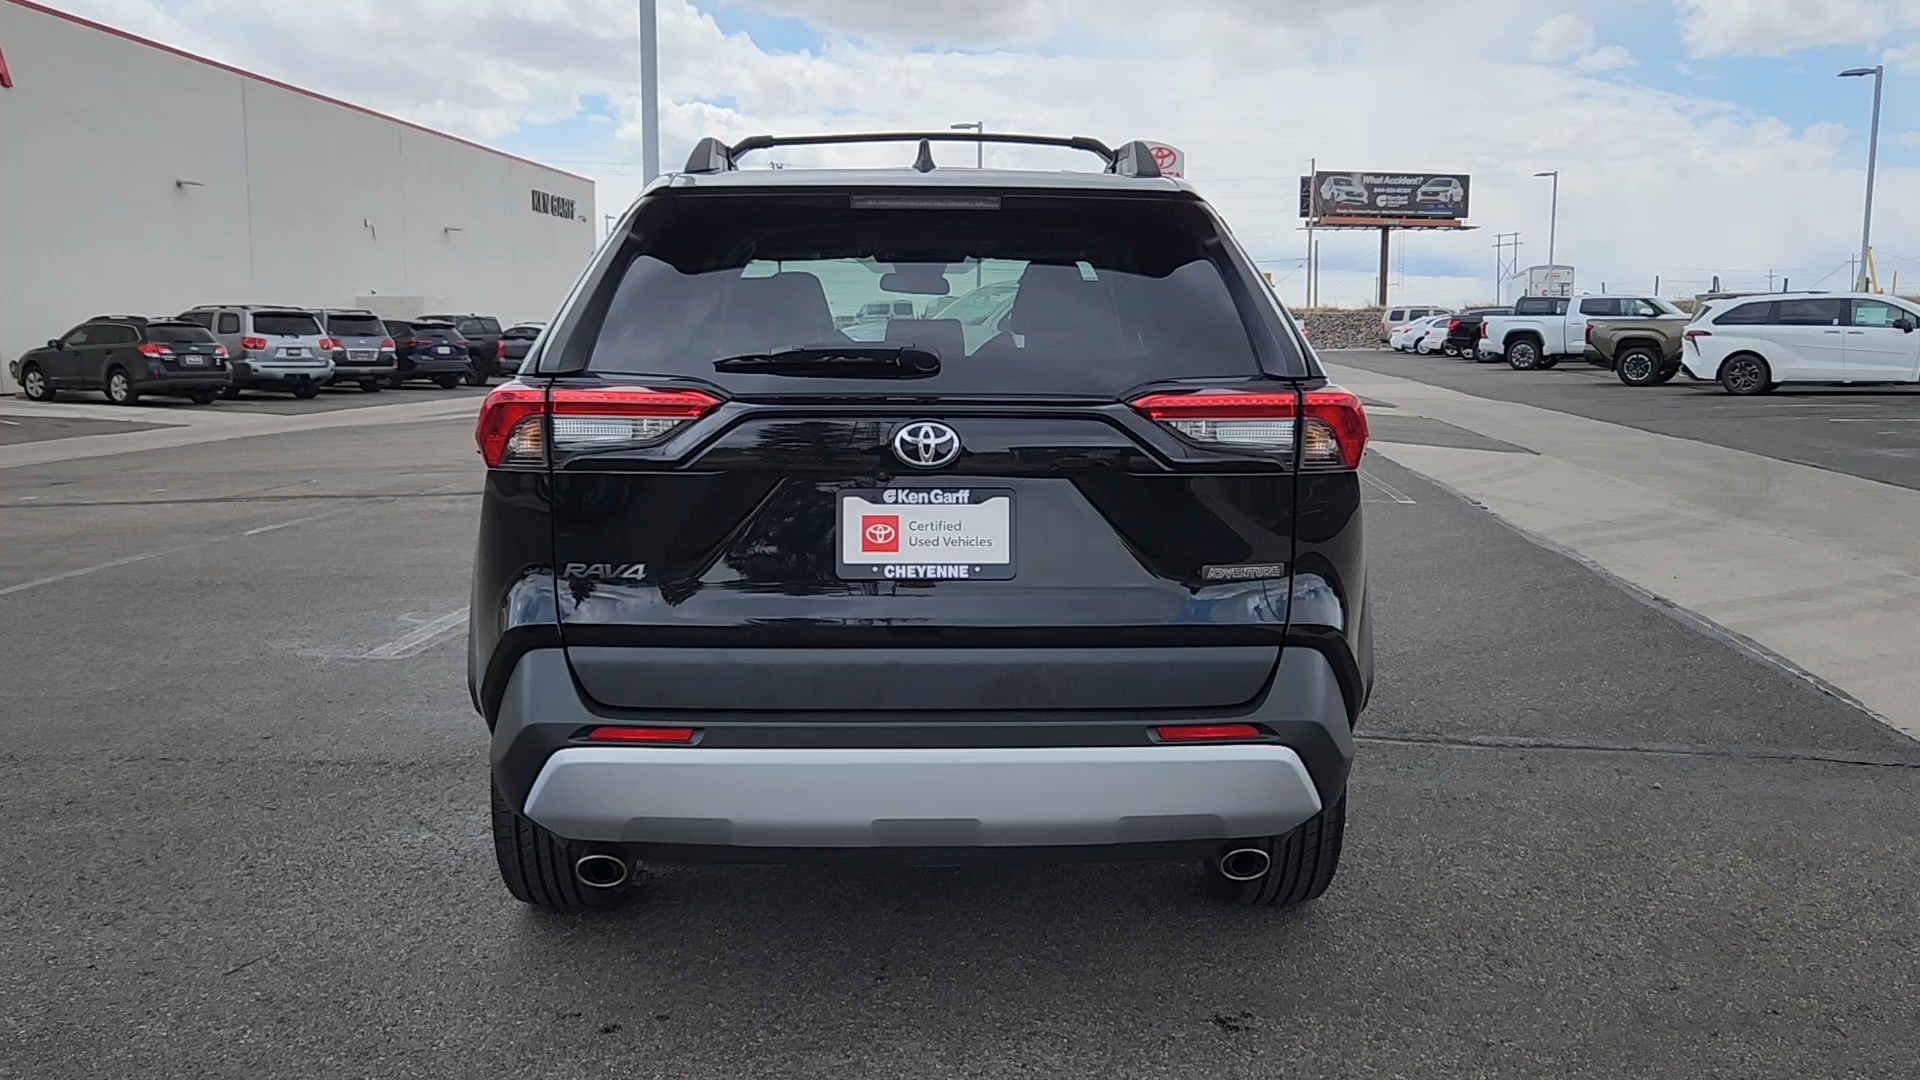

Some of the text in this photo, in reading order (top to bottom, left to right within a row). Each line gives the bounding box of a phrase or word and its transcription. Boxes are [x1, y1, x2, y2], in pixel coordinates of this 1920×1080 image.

[1363, 175, 1424, 187] What Accident?
[531, 189, 550, 214] KEN
[898, 489, 970, 504] Ken Garff
[908, 520, 962, 532] Certified
[908, 536, 993, 547] Used Vehicles
[563, 563, 647, 580] RAV4
[884, 565, 969, 578] CHEYENNE
[1206, 565, 1281, 579] ADVENTURE
